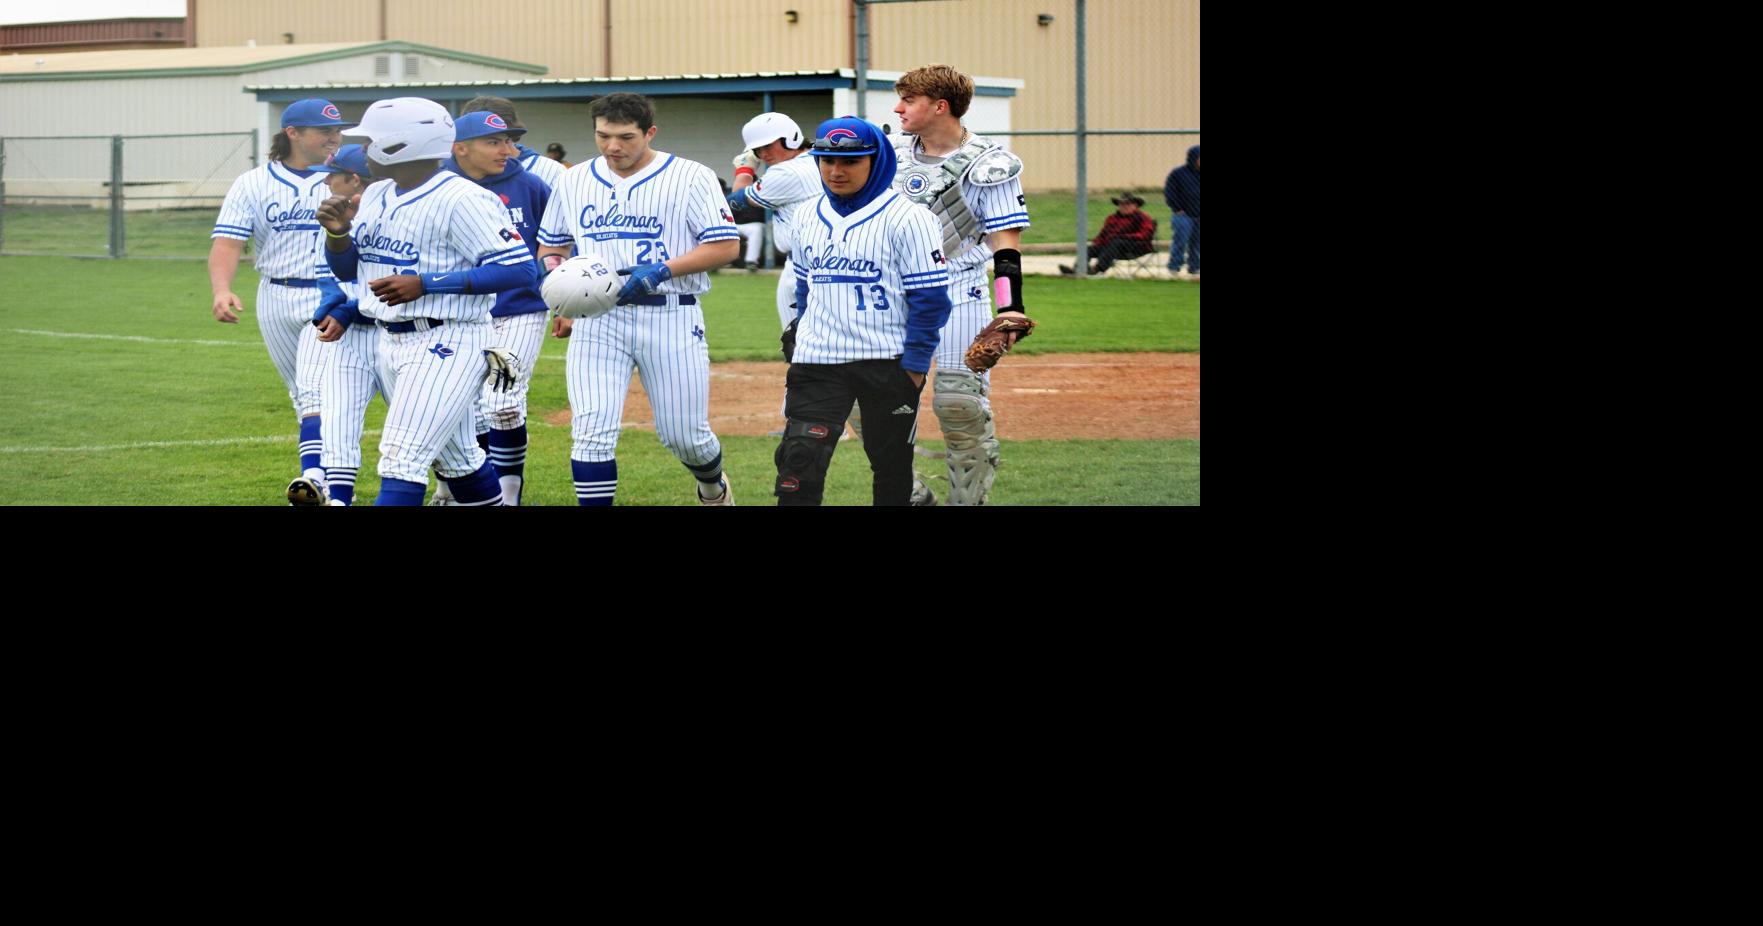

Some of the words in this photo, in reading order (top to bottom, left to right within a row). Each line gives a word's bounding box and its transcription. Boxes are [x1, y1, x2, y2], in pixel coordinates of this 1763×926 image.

[580, 203, 663, 230] Coleman
[637, 241, 670, 265] 23
[805, 244, 882, 273] Coleman
[855, 285, 890, 311] 13
